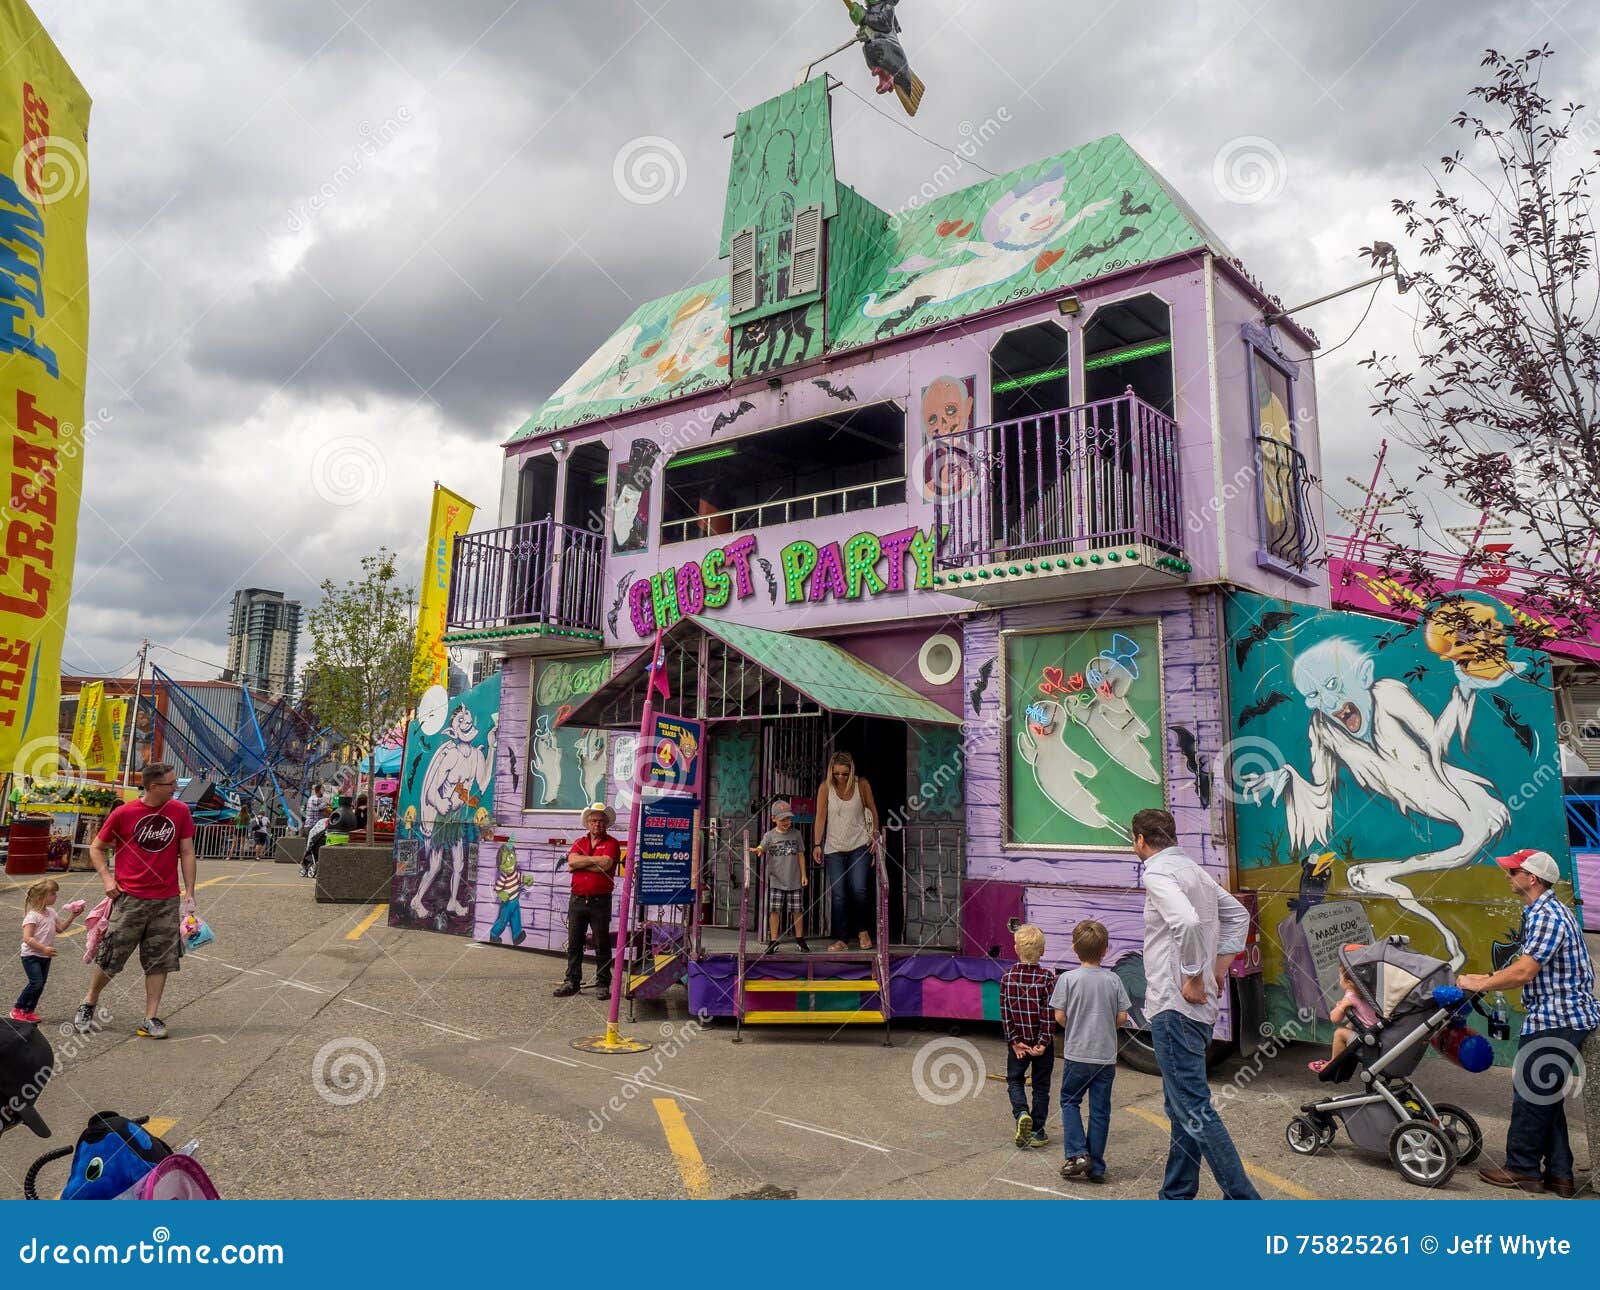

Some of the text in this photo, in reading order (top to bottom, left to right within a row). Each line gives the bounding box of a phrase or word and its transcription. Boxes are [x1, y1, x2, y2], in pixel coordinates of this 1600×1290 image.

[0, 389, 59, 619] GREAT
[628, 524, 948, 638] GHOST PARTY
[660, 743, 672, 764] 4
[137, 822, 174, 842] Hurley
